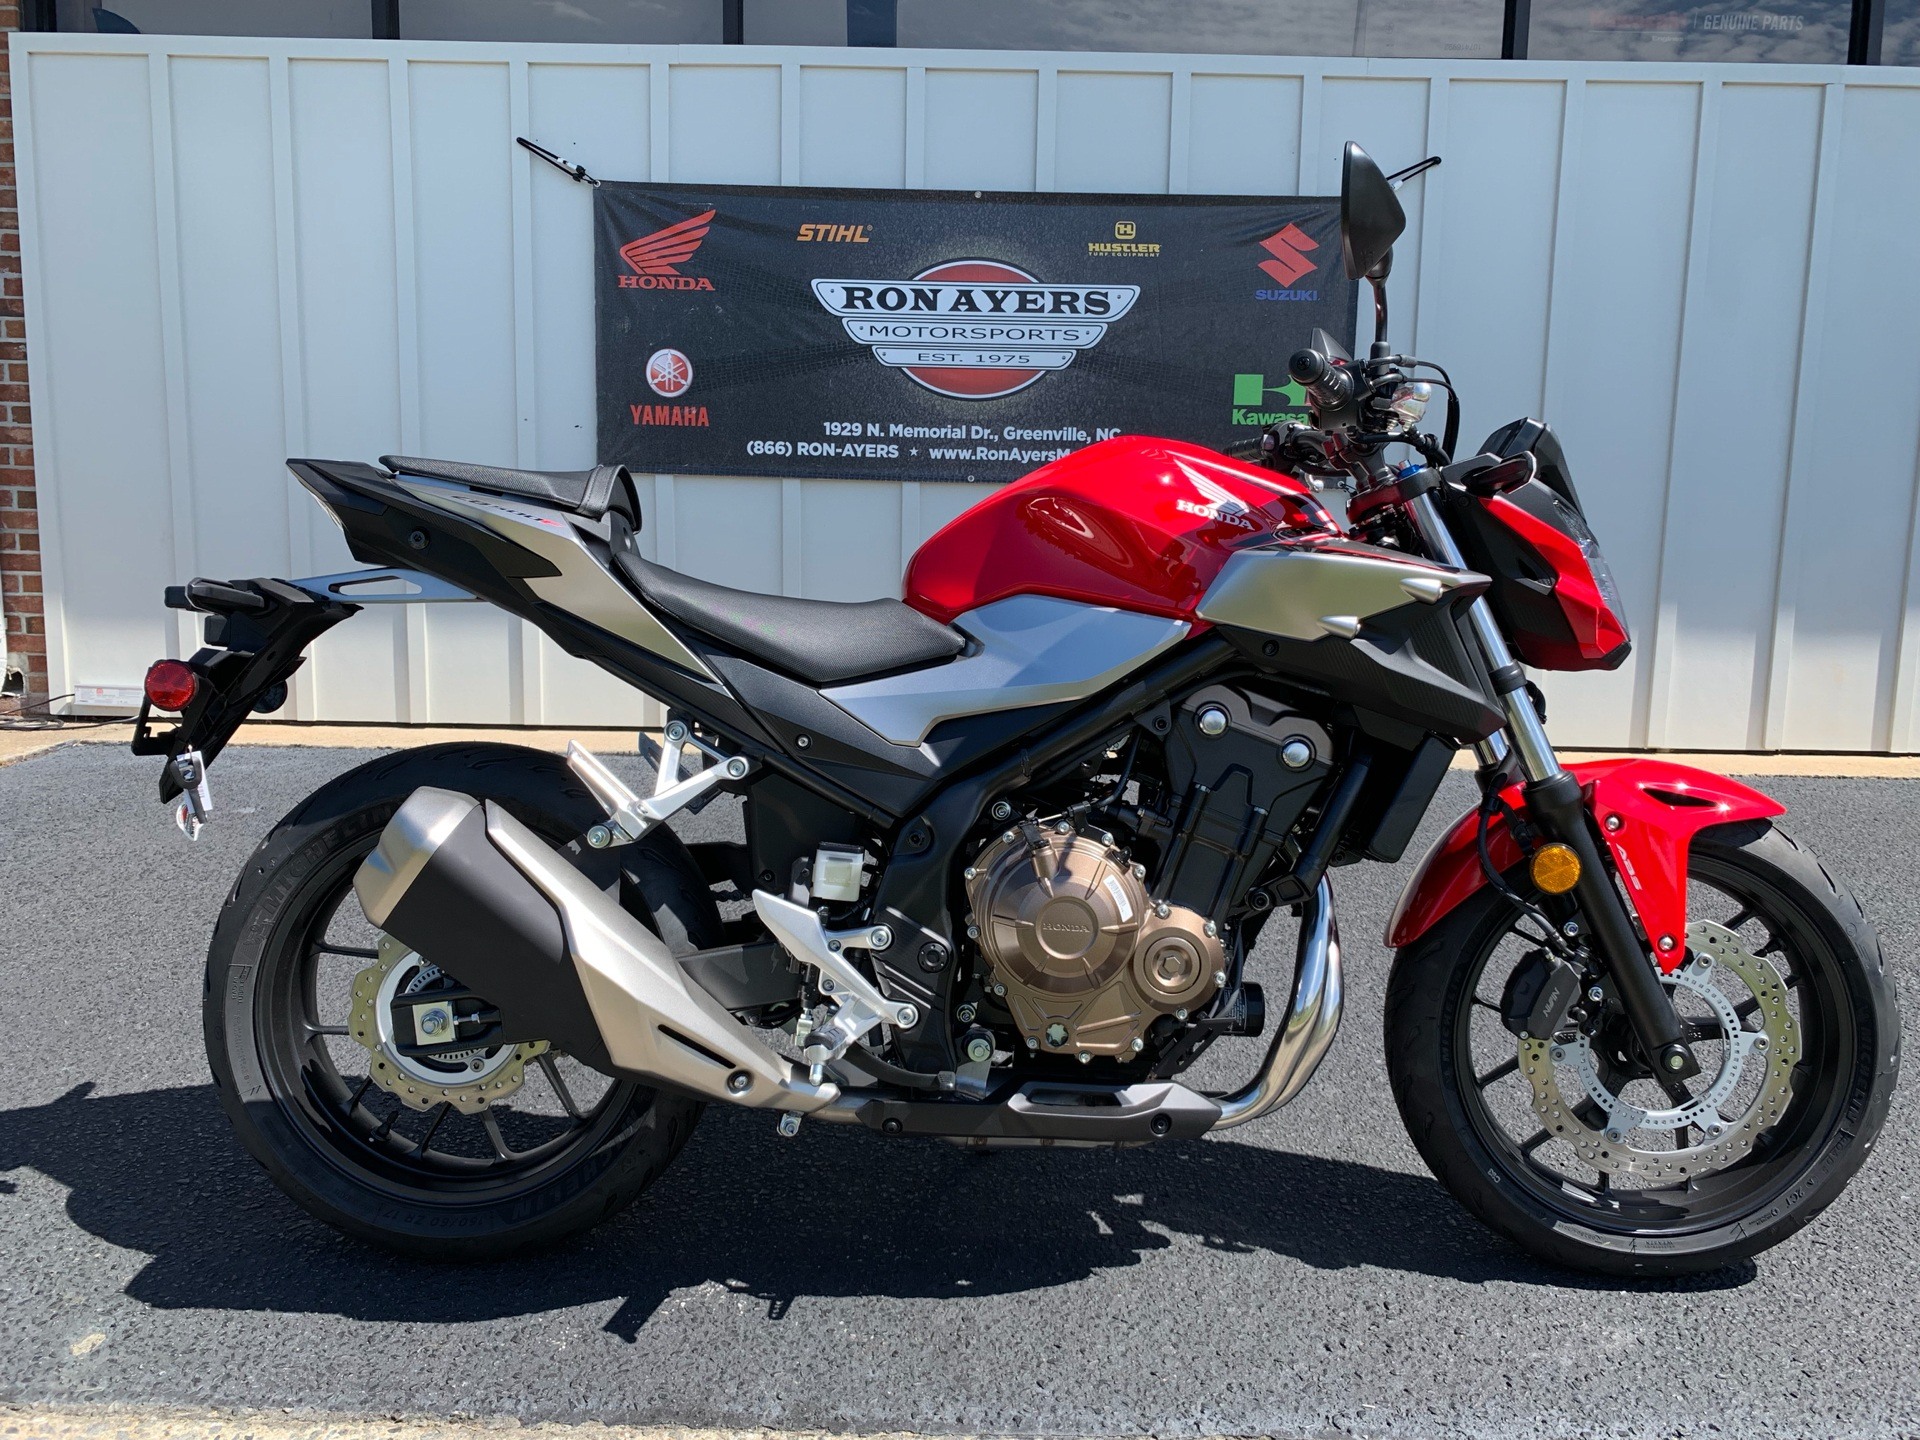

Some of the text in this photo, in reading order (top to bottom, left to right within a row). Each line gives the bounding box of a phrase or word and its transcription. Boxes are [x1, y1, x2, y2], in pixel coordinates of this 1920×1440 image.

[1703, 14, 1758, 31] GENUINE
[1762, 15, 1804, 31] PARTS
[1088, 243, 1160, 252] HUSTLER
[618, 275, 715, 291] HONDA
[841, 286, 1111, 315] RON AYERS
[1255, 289, 1318, 301] SUZUKI
[869, 325, 1080, 341] MOTORSPORTS
[917, 353, 1030, 364] EST. 1975
[630, 405, 709, 427] YAMAHA
[823, 422, 1121, 444] 1929 N. Memorial Dr., Greenville, NC
[747, 441, 792, 457] (866)
[797, 442, 899, 458] RON-AYERS
[1176, 499, 1255, 531] HONDA
[261, 805, 393, 914] MICHELIN
[1615, 843, 1643, 890] ABS
[1042, 922, 1090, 933] HONDA
[1542, 987, 1561, 1018] NISSIN
